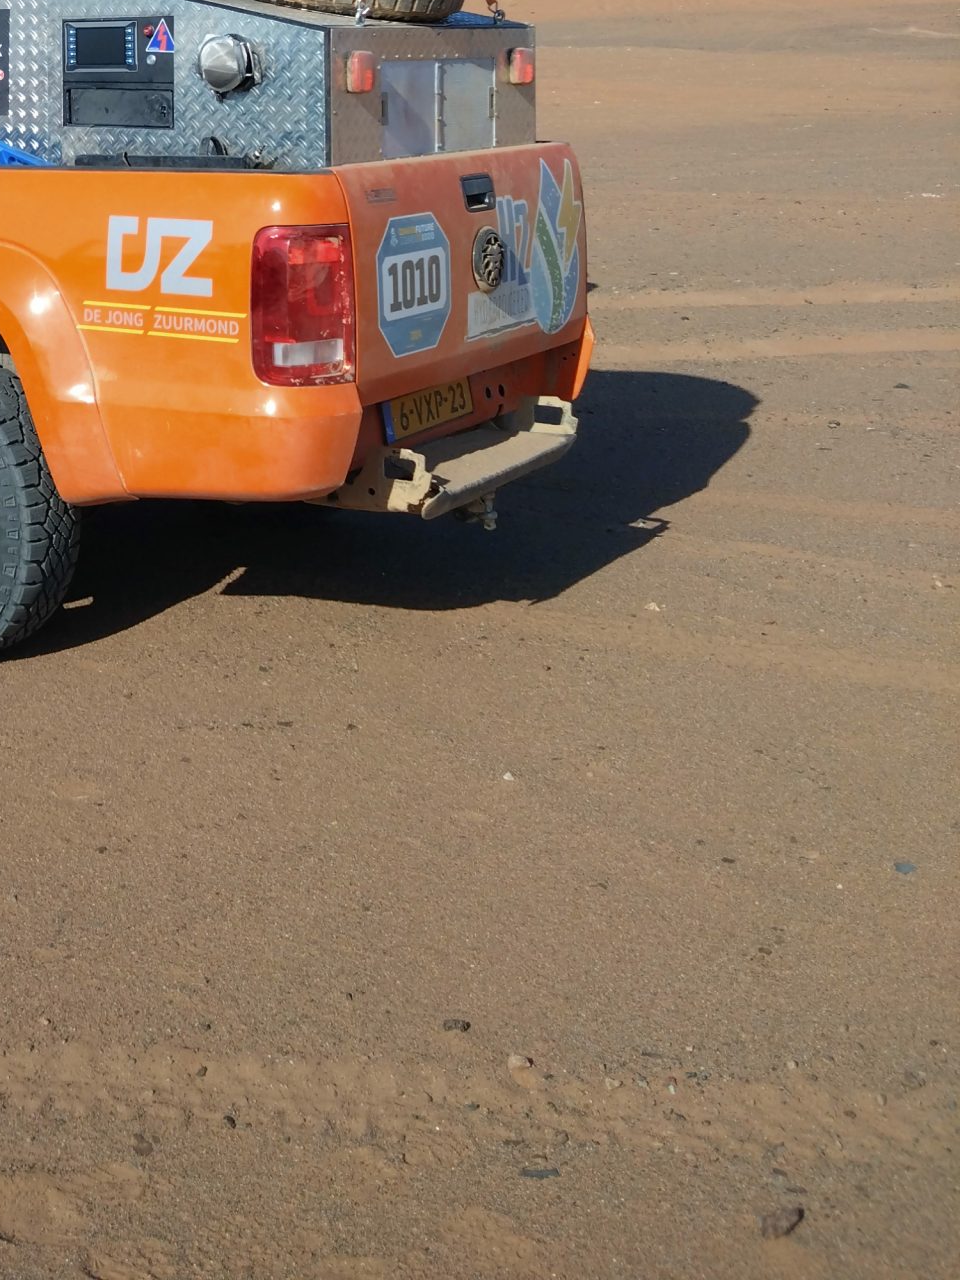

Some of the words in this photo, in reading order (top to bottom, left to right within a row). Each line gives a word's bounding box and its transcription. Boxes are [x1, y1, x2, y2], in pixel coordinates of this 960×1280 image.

[387, 254, 441, 313] 1010
[83, 308, 101, 323] DE
[105, 310, 144, 327] JONG
[153, 314, 240, 336] ZUURMOND
